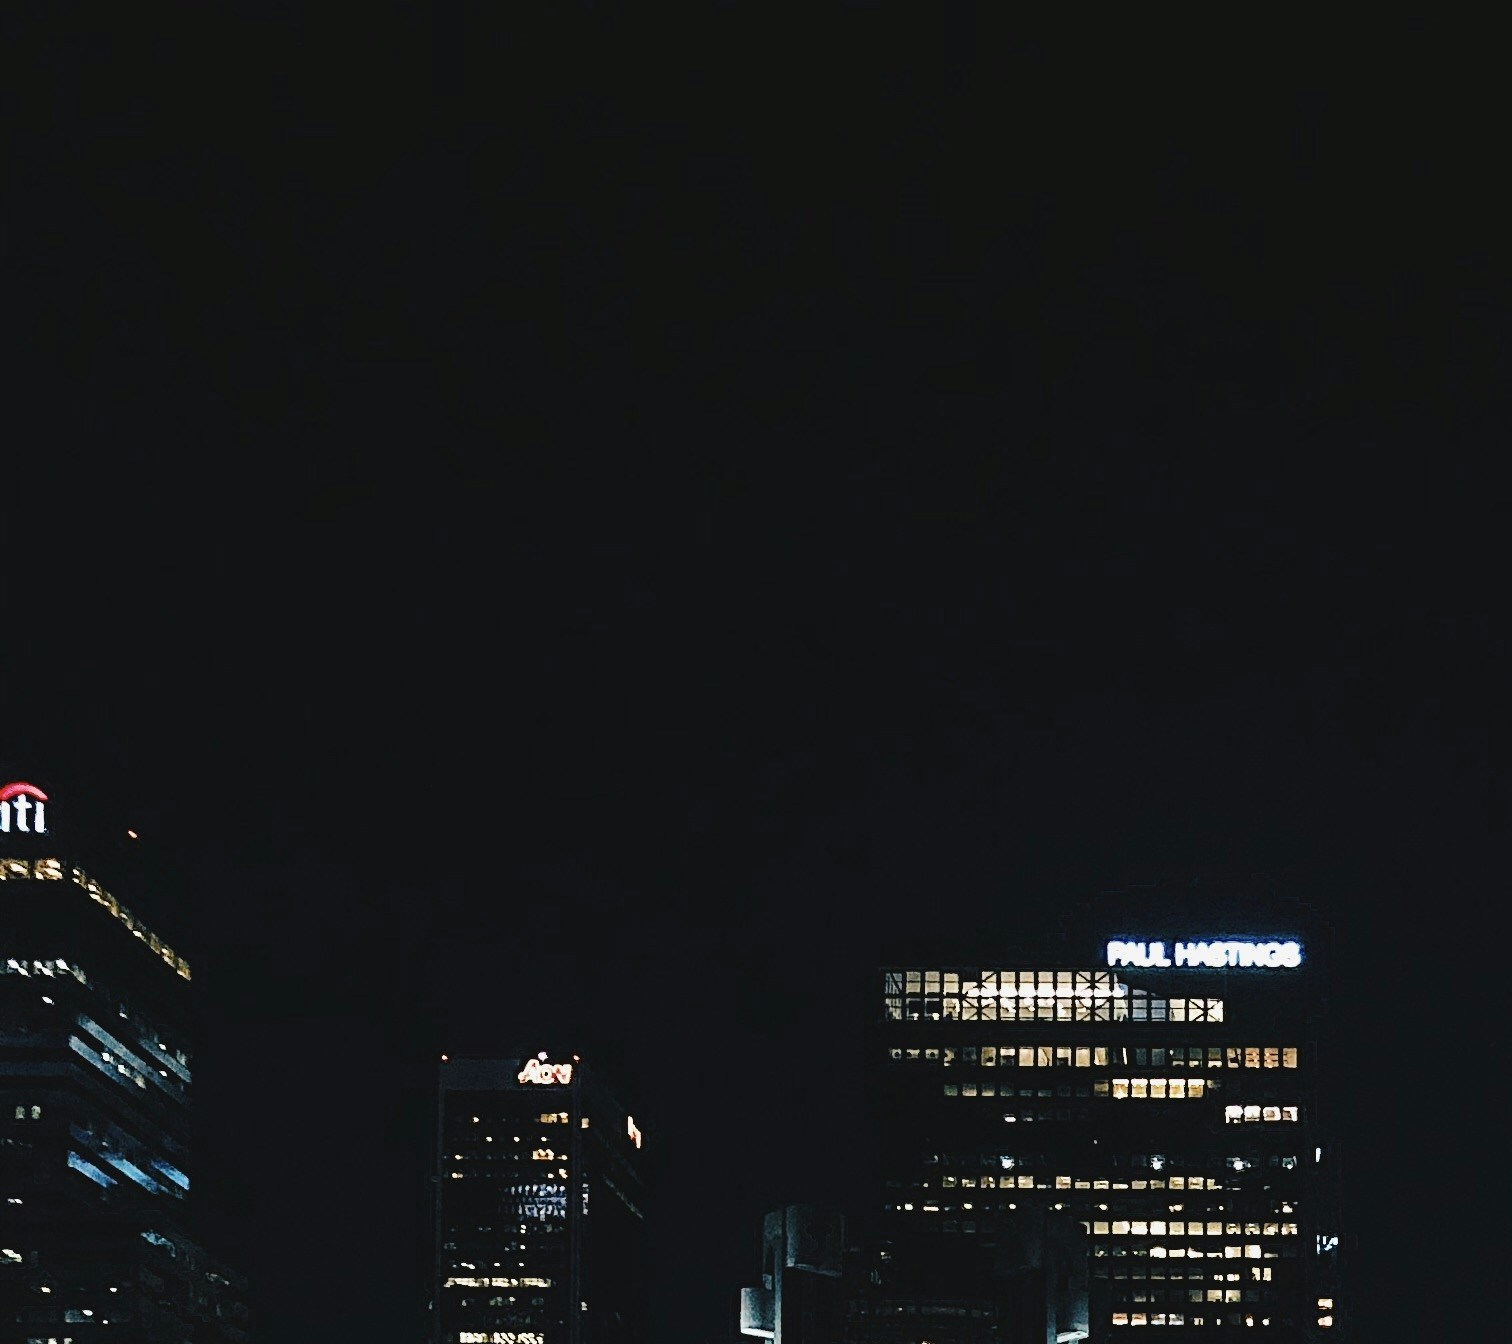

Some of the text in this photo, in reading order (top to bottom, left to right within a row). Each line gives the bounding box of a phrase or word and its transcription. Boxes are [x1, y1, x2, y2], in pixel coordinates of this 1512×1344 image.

[0, 793, 45, 833] iti
[1106, 941, 1301, 967] PAUL HASTINGS
